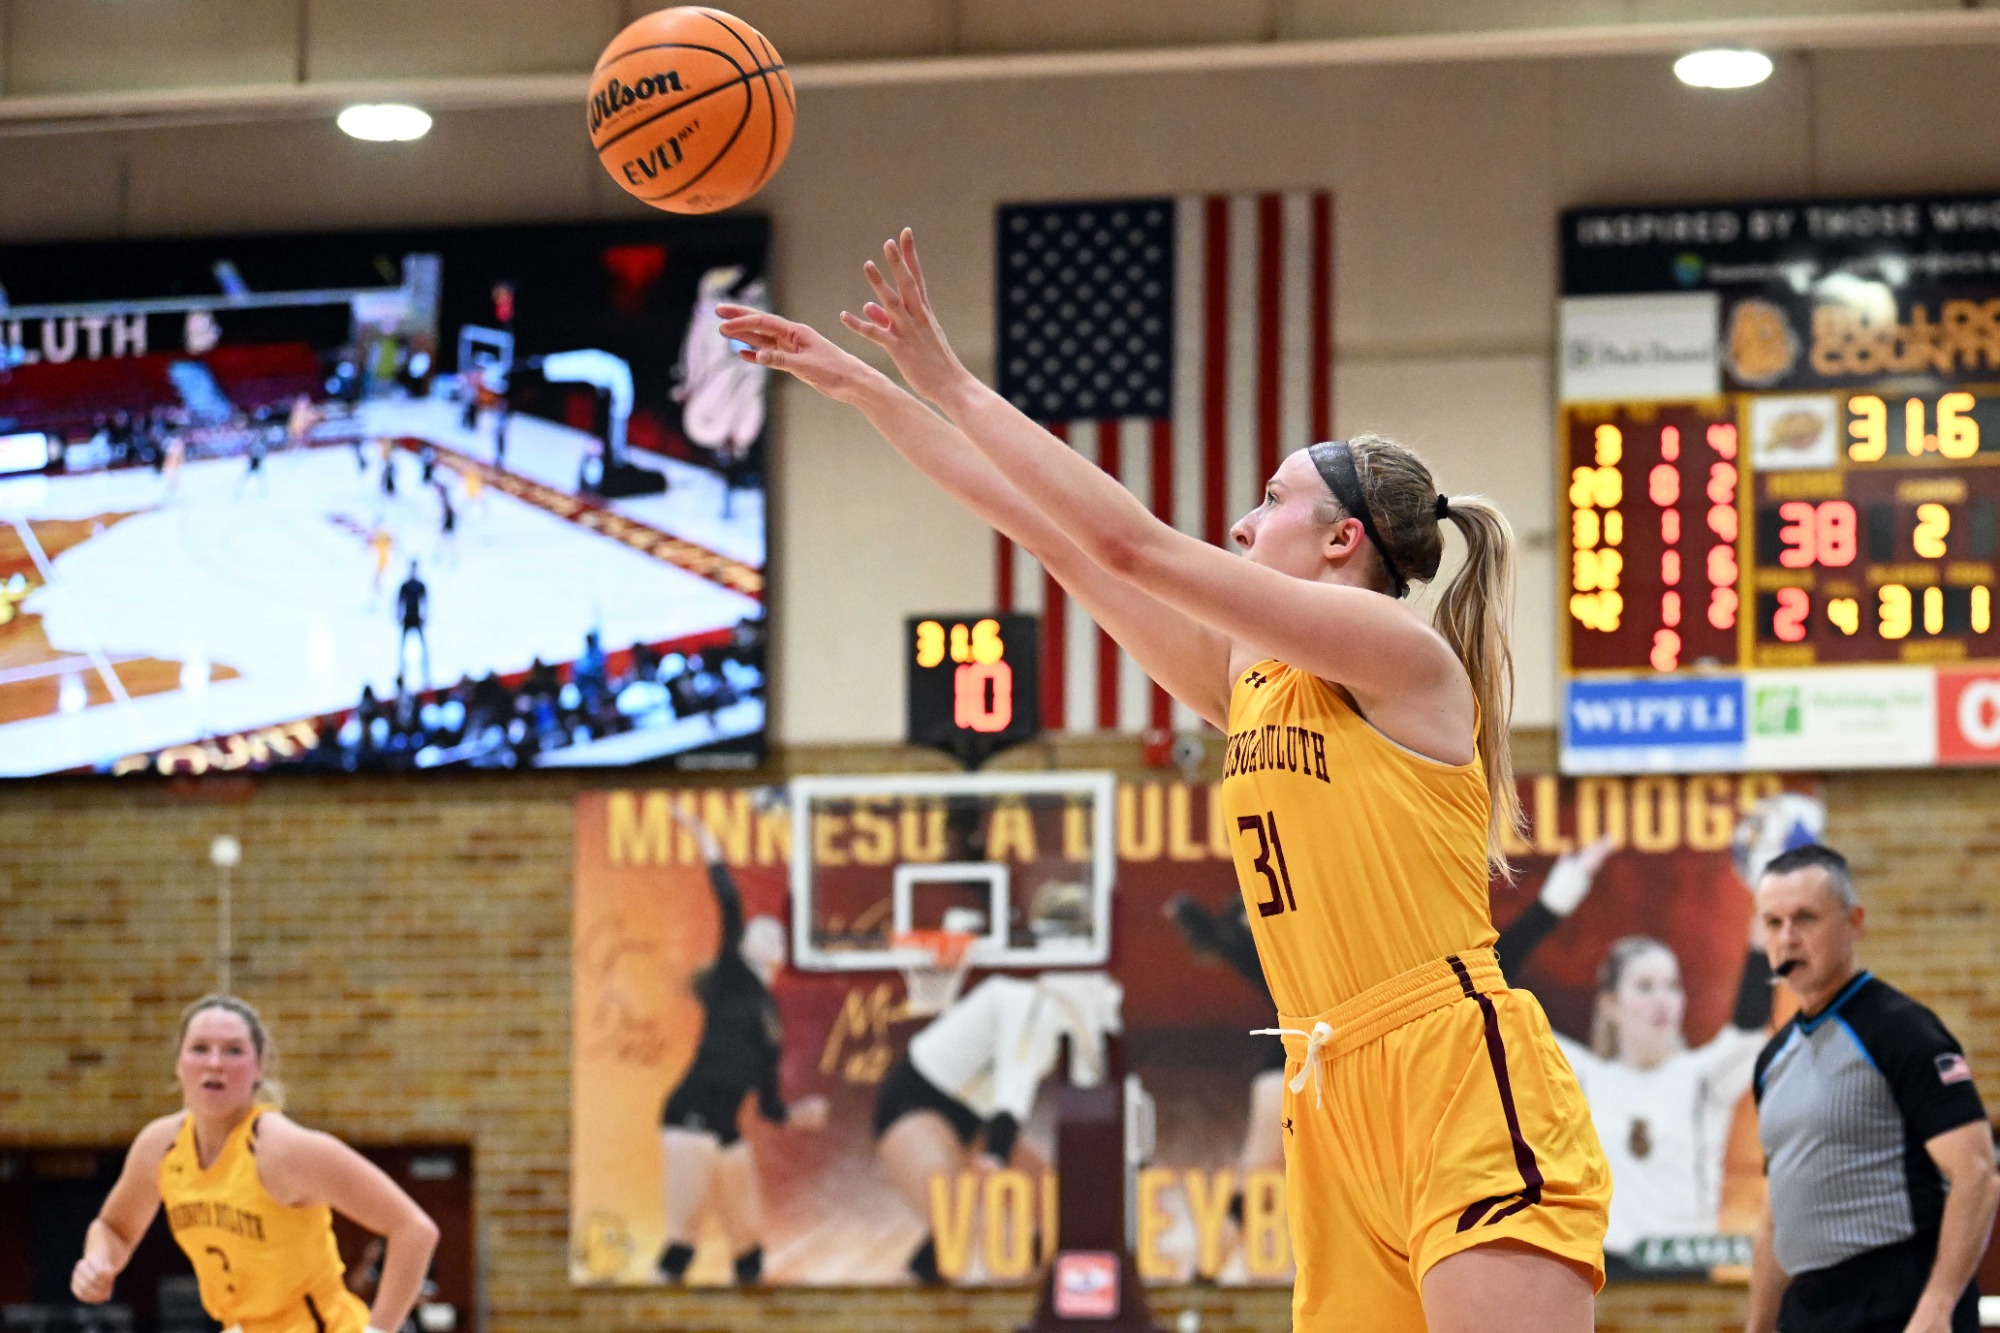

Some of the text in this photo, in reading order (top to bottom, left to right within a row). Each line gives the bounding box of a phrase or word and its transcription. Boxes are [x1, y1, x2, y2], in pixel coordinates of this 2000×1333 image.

[622, 137, 683, 185] EVO
[0, 315, 147, 364] LUTH
[1661, 425, 1680, 462] 1
[1848, 392, 1979, 462] 31.6
[1661, 508, 1680, 545] 1
[1779, 501, 1857, 568] 38
[1913, 503, 1950, 558] 2
[1661, 549, 1680, 586] 1
[1662, 590, 1681, 627] 1
[1773, 587, 1810, 642] 2
[954, 660, 1012, 732] 10
[1572, 693, 1737, 732] WIPFLI
[607, 787, 1038, 864] MINNESOA
[1237, 811, 1297, 917] 31
